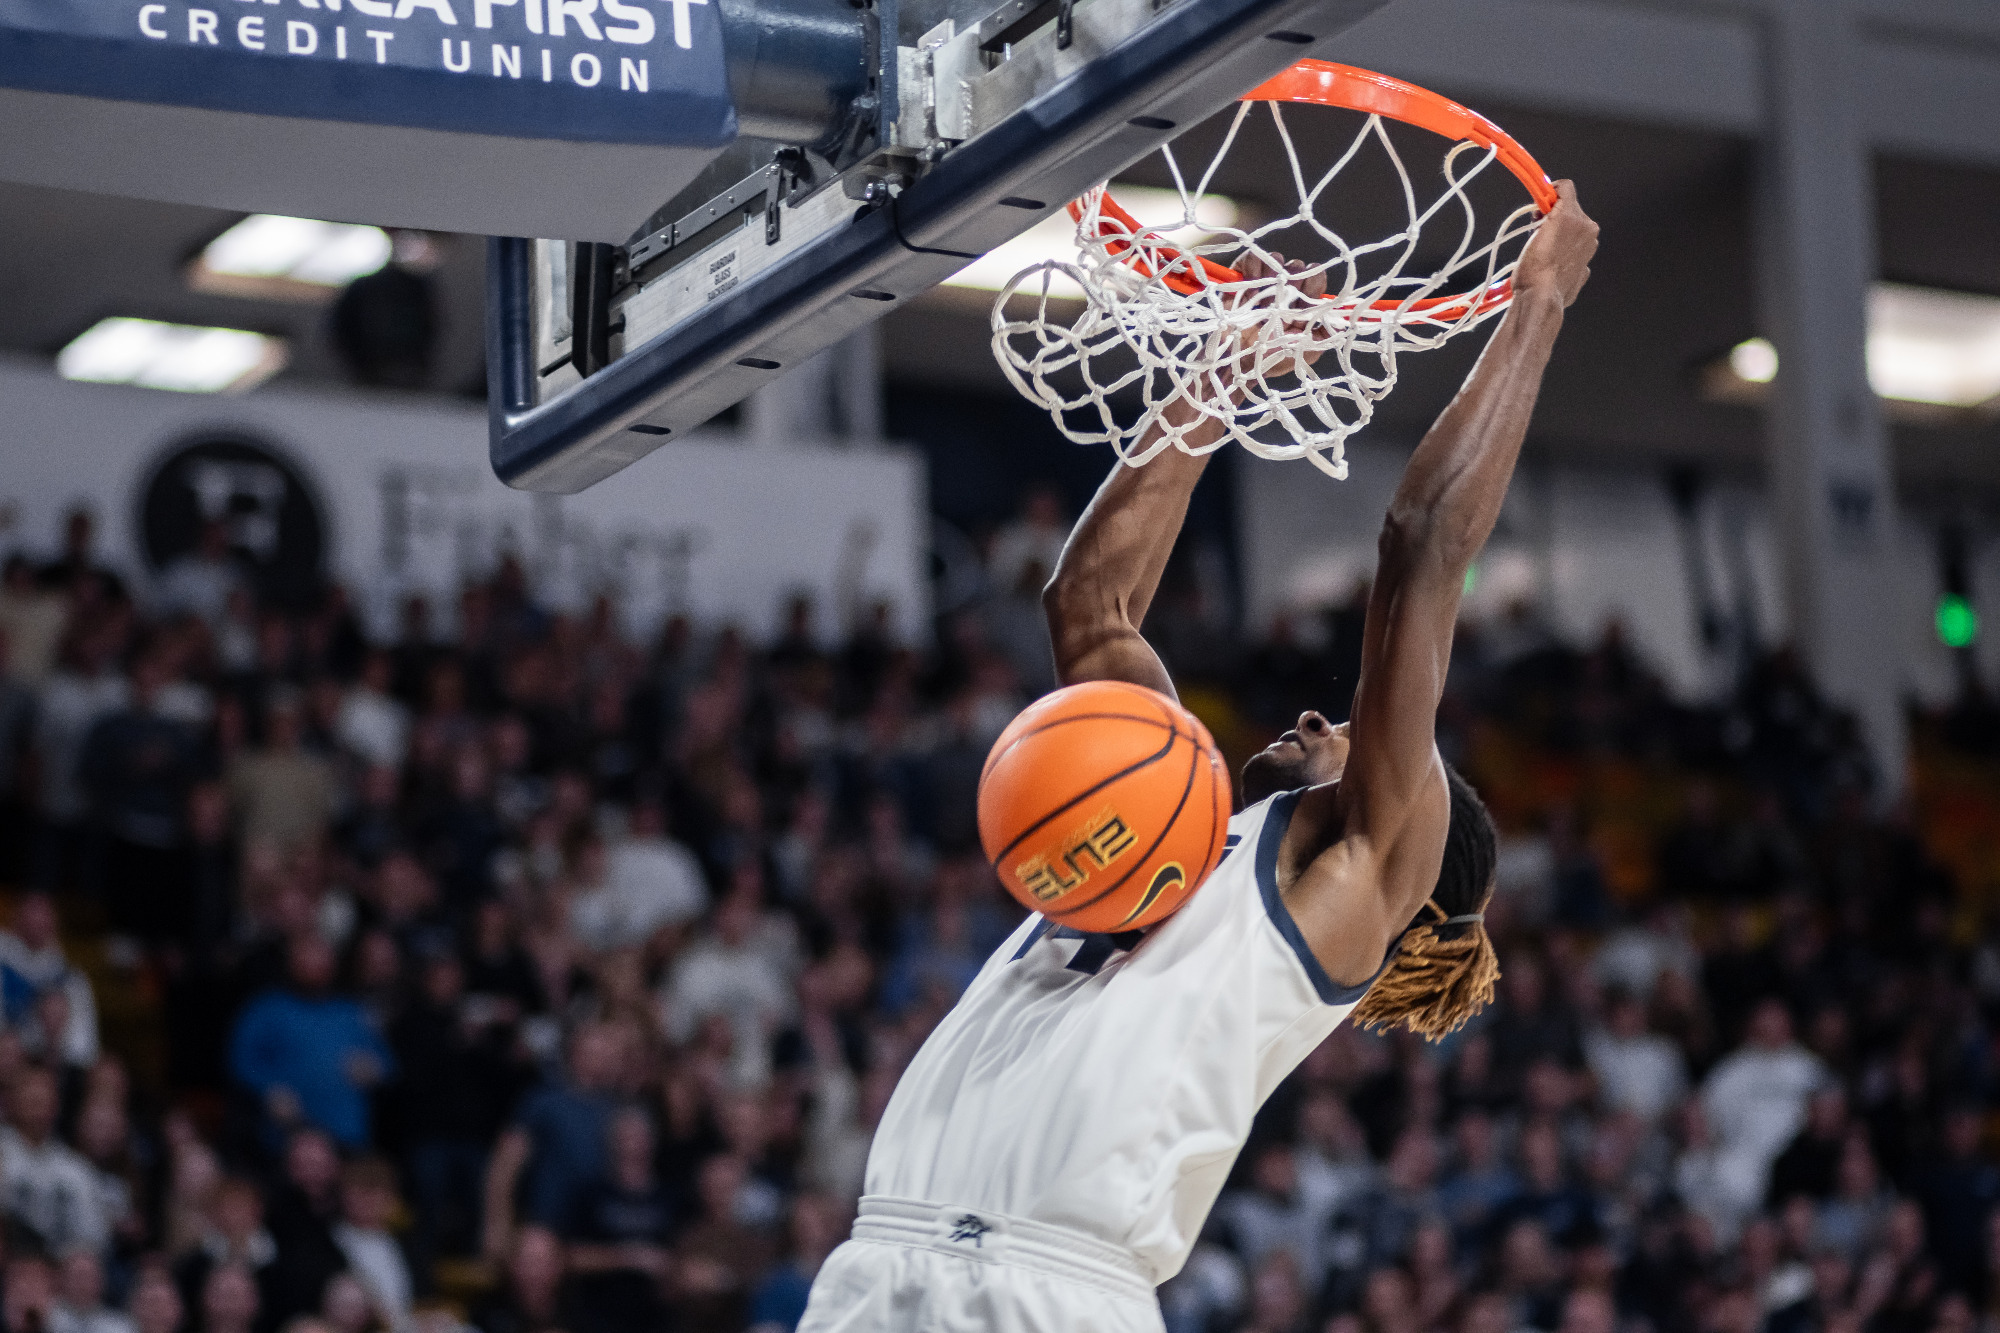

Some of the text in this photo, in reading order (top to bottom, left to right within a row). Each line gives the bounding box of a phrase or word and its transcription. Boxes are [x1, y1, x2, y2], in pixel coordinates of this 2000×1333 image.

[138, 4, 405, 64] CREDIT
[441, 37, 649, 93] UNION
[714, 267, 731, 286] GLASS
[1019, 812, 1138, 901] ELITE
